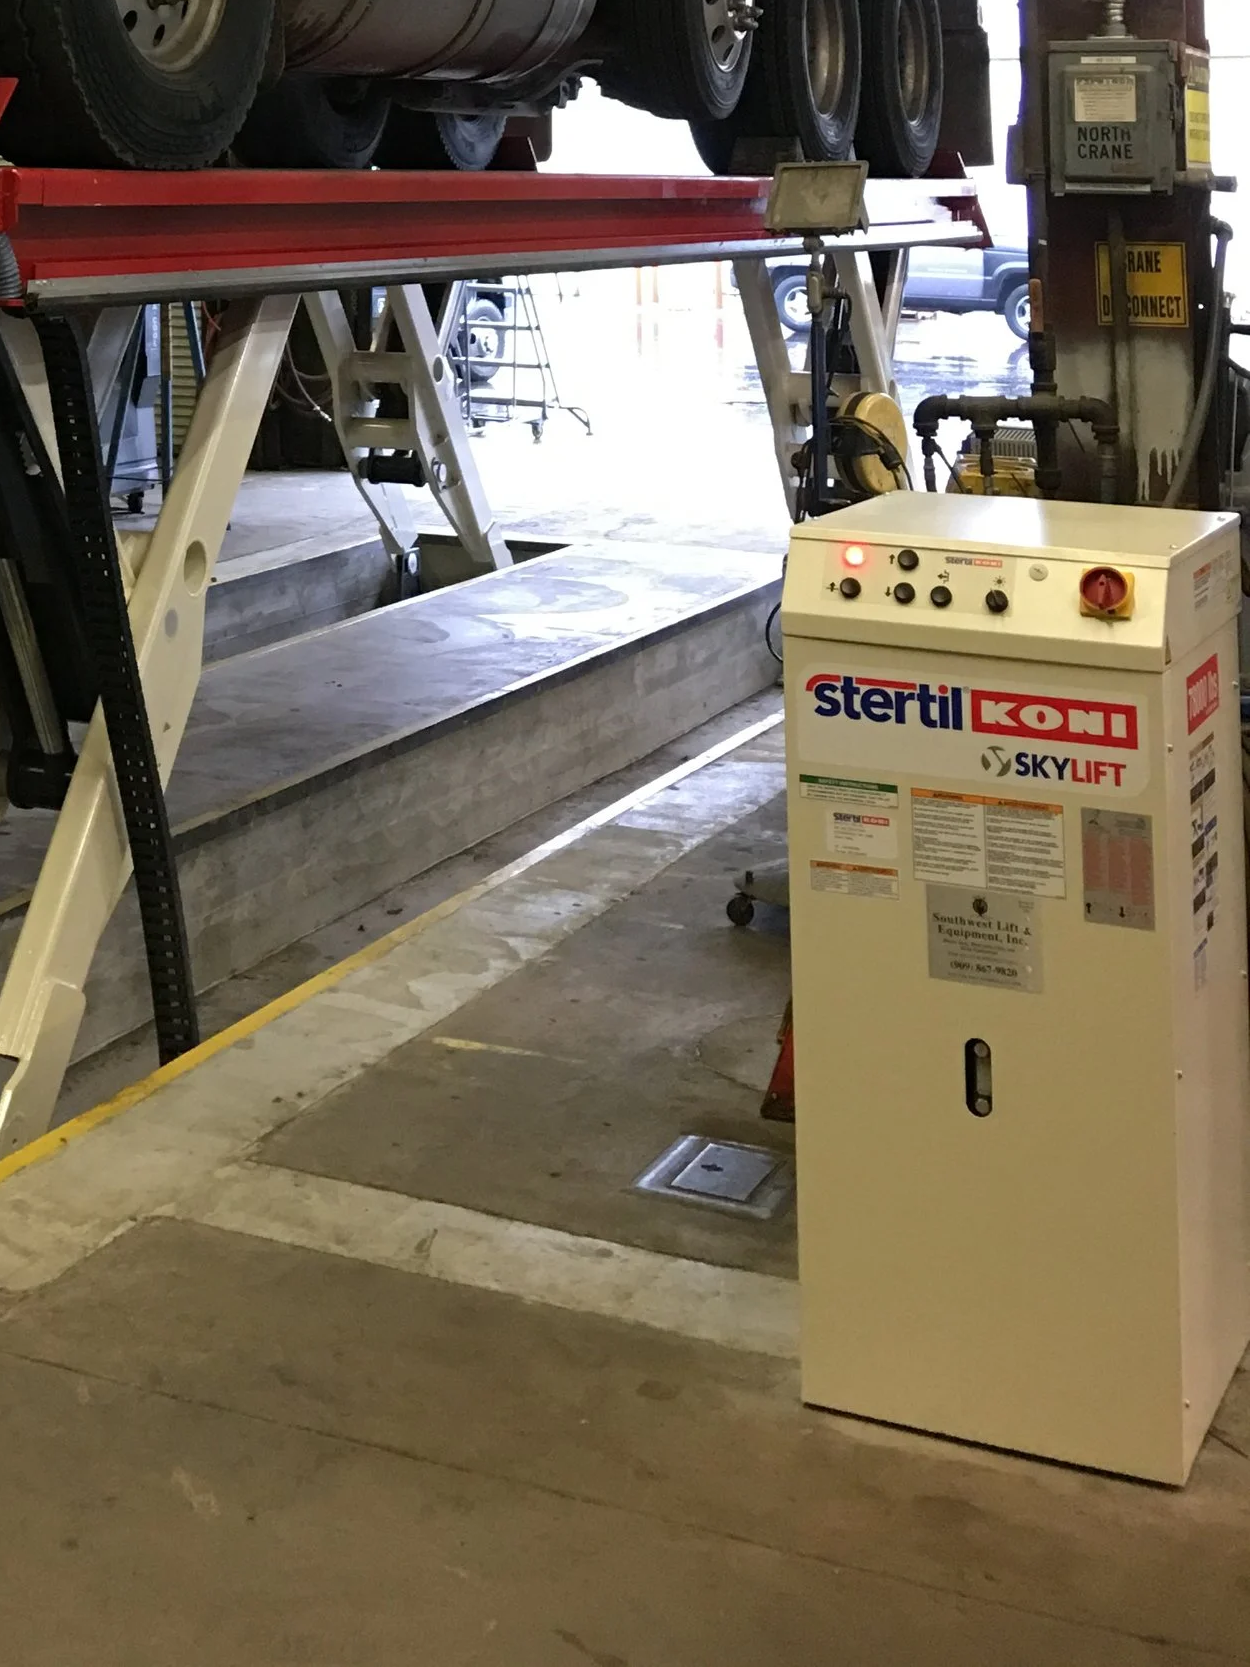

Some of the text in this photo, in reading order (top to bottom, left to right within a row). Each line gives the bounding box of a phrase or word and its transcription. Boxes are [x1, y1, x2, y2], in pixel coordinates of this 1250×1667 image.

[1077, 126, 1132, 142] NORTH
[1077, 143, 1134, 159] CRANE
[1127, 250, 1162, 274] RANE
[810, 675, 1128, 739] stertil KONI
[1015, 752, 1127, 787] SKYLIFT
[932, 912, 1032, 936] Southwest Lift &
[1006, 934, 1029, 946] Inc.
